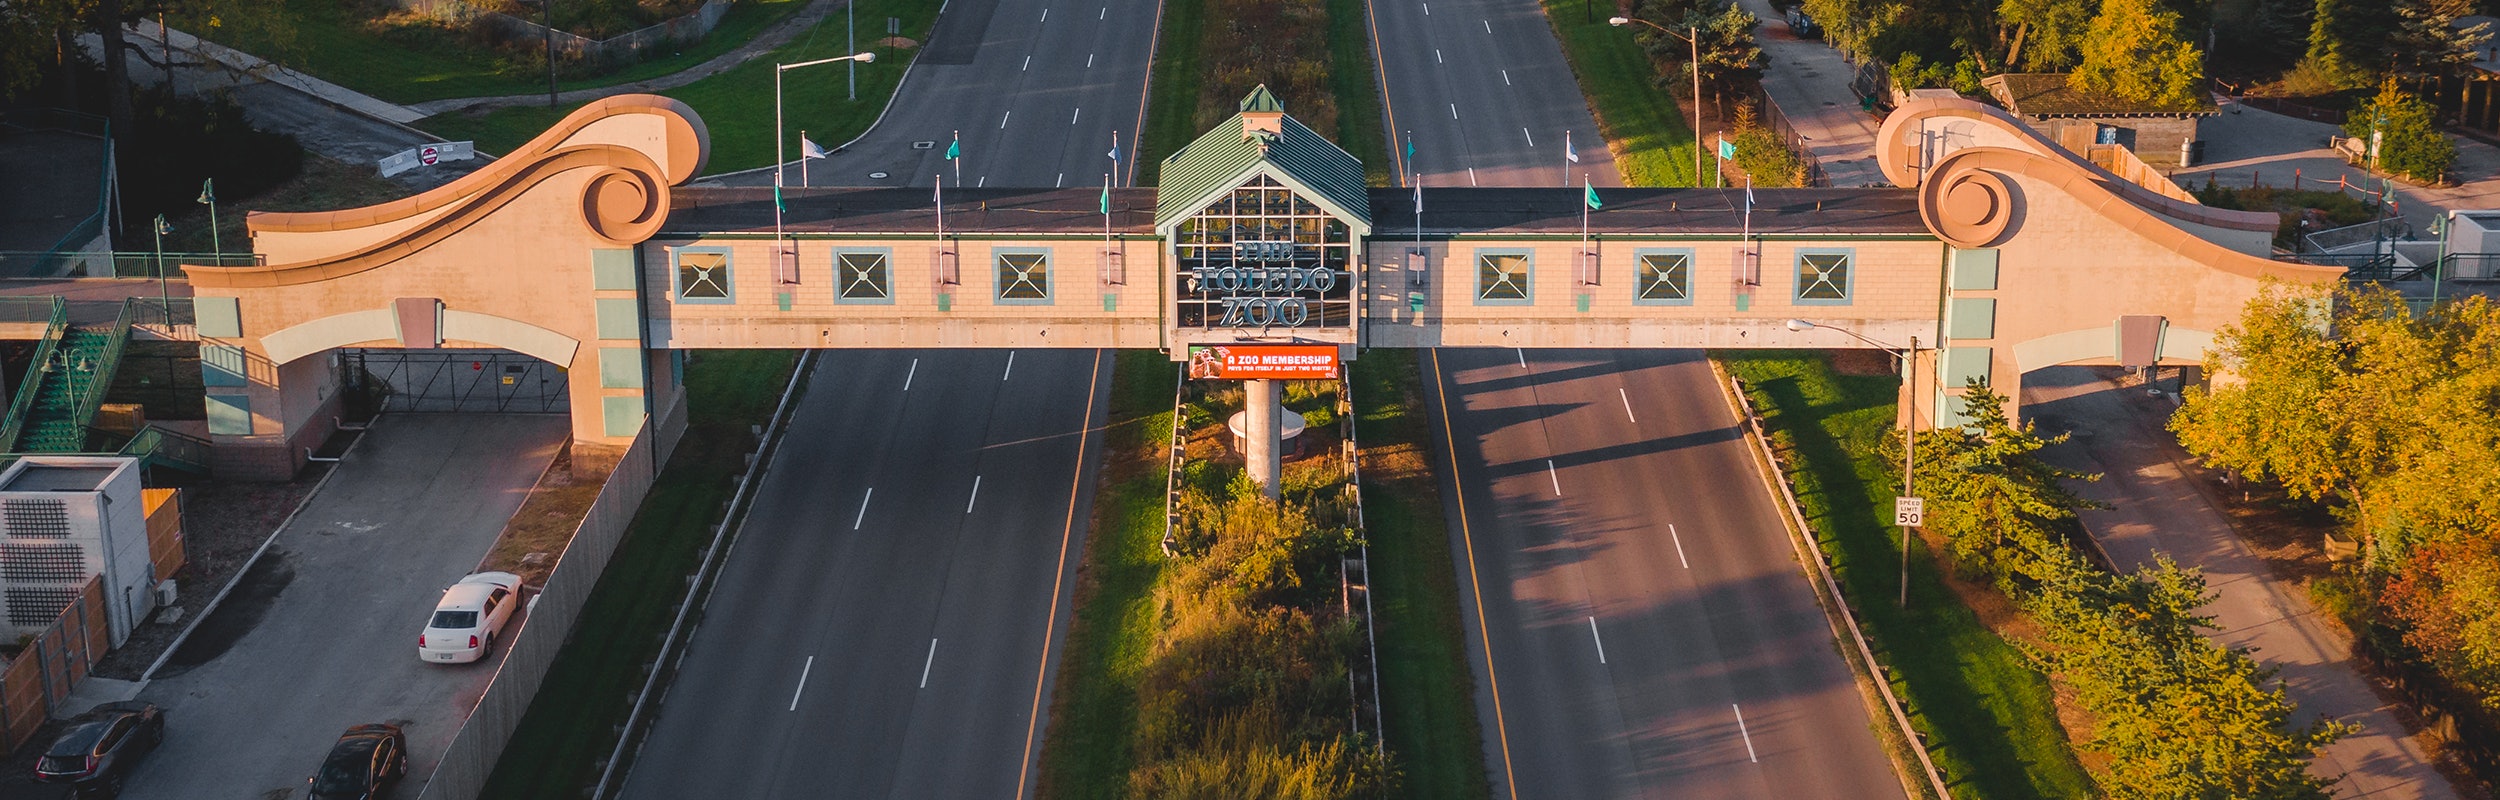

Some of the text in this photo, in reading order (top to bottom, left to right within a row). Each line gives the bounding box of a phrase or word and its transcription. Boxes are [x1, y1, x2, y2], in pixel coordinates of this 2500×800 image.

[1235, 240, 1294, 261] THE
[1192, 266, 1336, 293] TOLEDO
[1220, 297, 1308, 327] ZOO
[1227, 355, 1332, 365] A ZOO MEMBERSHIP
[1899, 513, 1918, 523] 50
